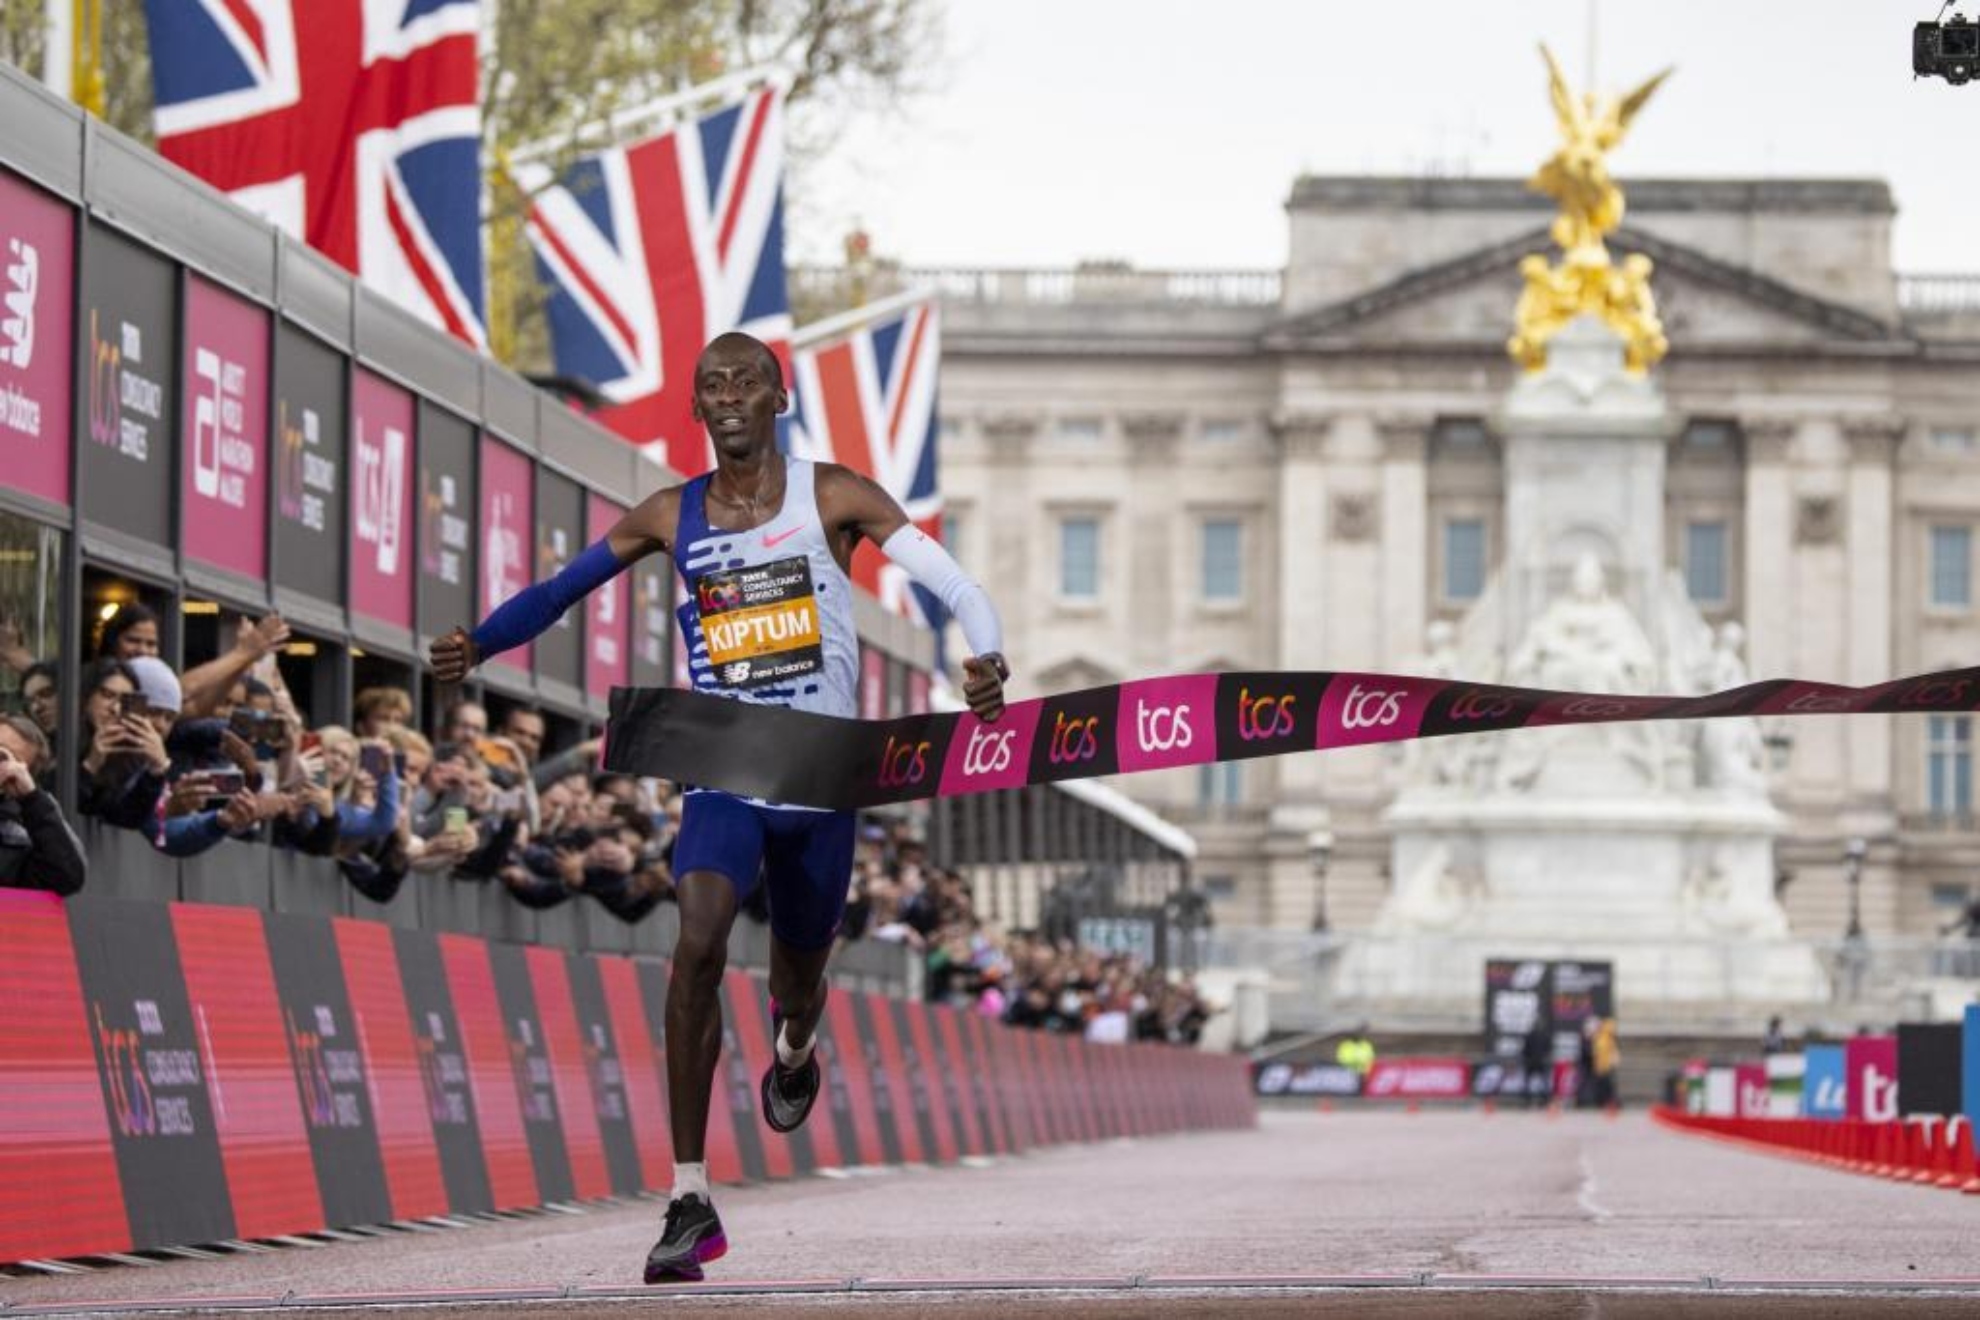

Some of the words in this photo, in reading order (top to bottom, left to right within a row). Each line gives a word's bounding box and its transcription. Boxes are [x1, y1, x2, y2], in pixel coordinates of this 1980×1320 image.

[743, 573, 803, 592] CONSULTANCY
[708, 607, 812, 653] KIPTUM
[774, 659, 814, 676] balance
[1137, 698, 1193, 751] tcs
[1238, 687, 1296, 740] tcs
[1340, 683, 1408, 729] tcs
[878, 735, 931, 787] tcs
[963, 724, 1017, 775] tcs
[1049, 710, 1099, 763] tcs
